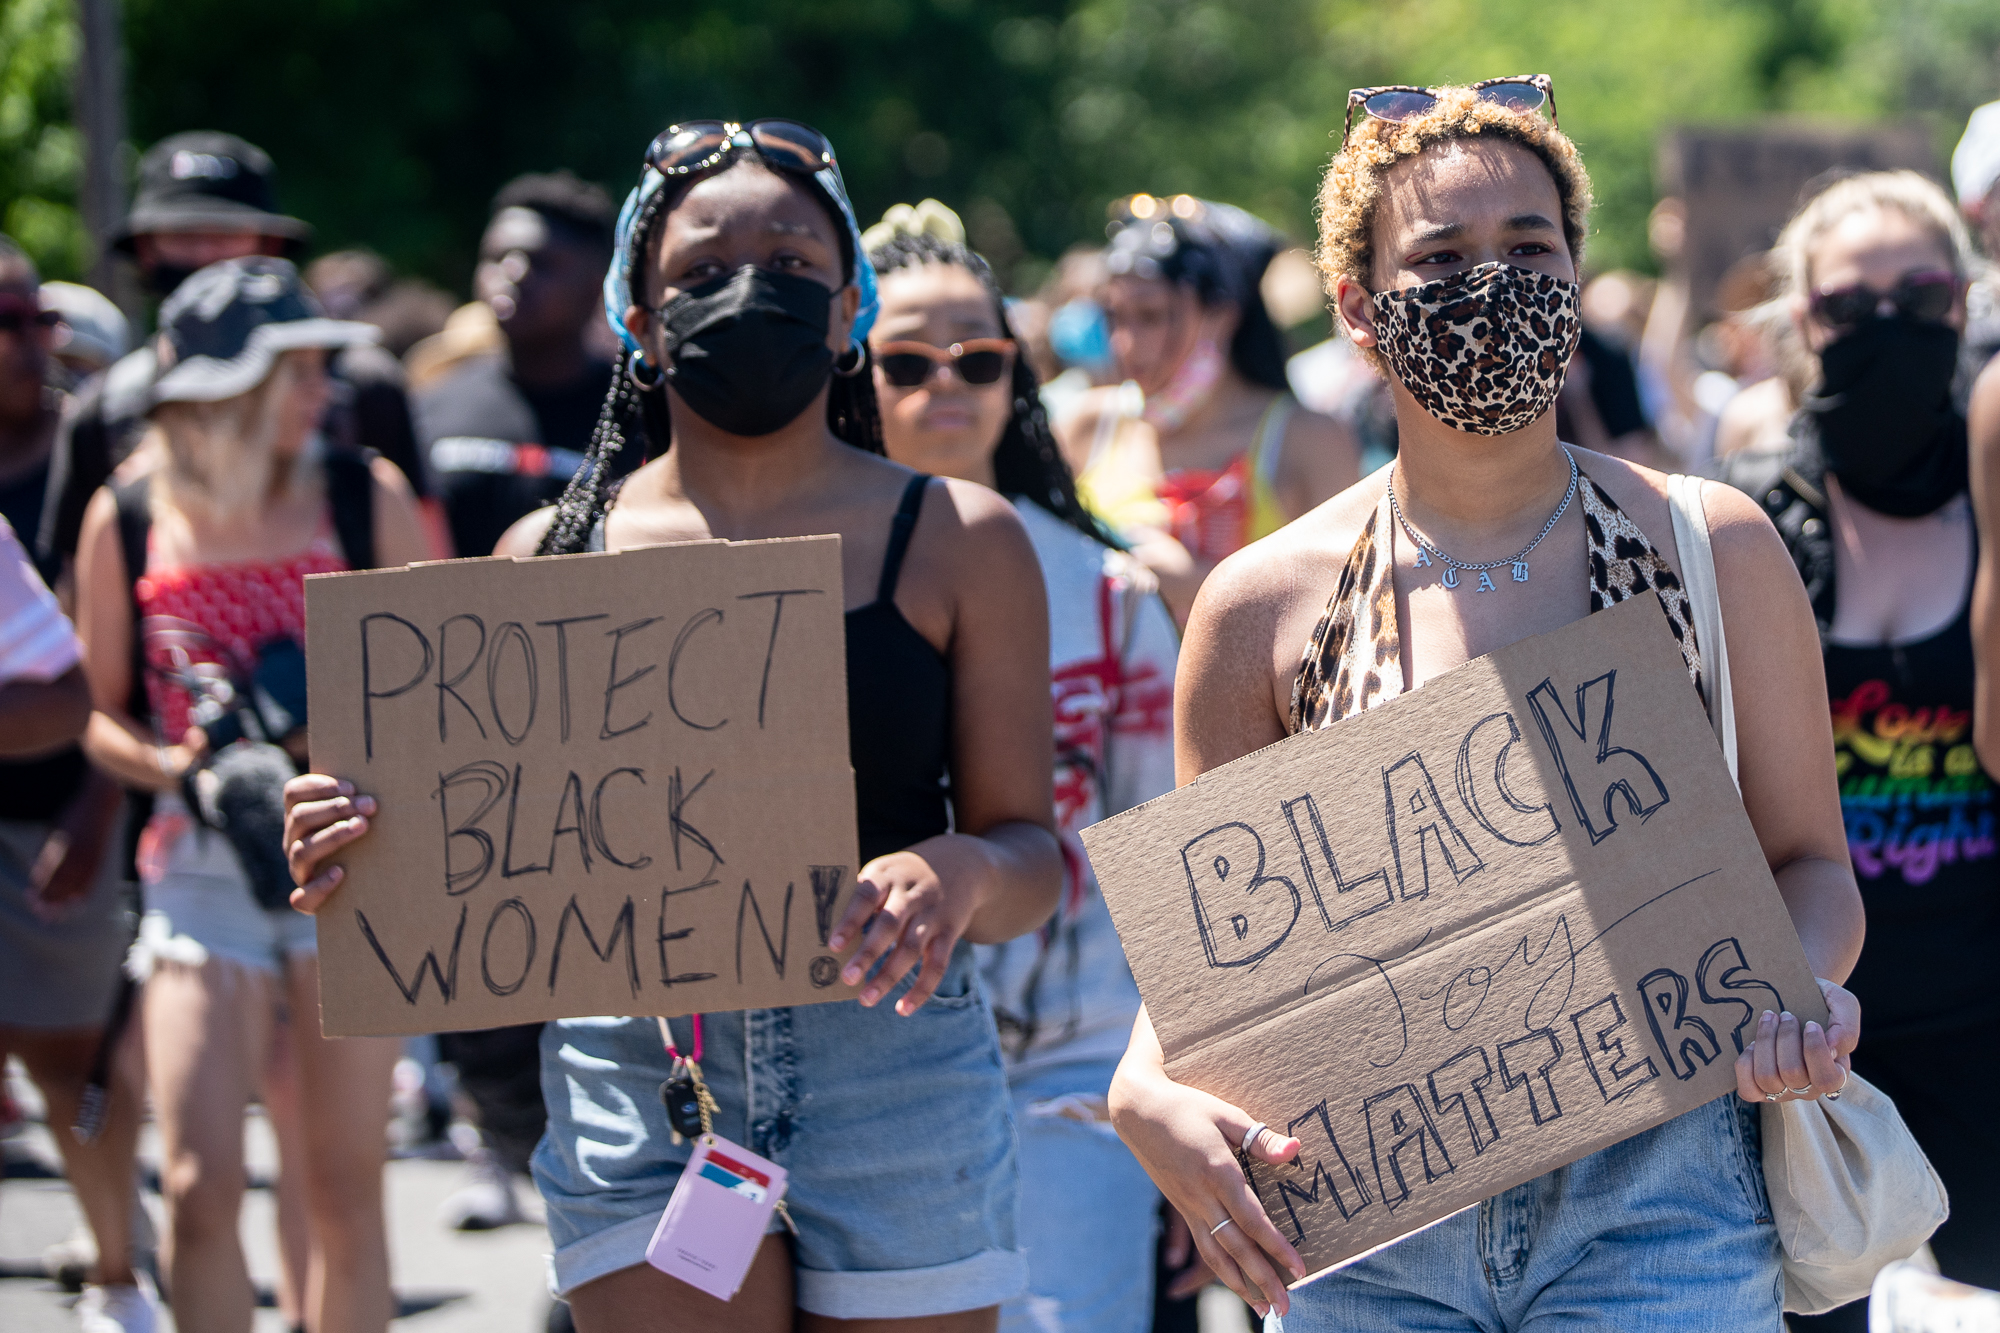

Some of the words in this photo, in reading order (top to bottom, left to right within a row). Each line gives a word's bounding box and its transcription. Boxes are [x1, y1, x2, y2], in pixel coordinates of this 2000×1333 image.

[1412, 545, 1529, 593] ACAB
[362, 589, 824, 760] PROTECT
[431, 762, 724, 896] BLACK
[1180, 669, 1670, 970] BLACK
[357, 865, 849, 1005] WOMEN!
[1303, 868, 1722, 1069] Joy
[1239, 936, 1786, 1248] MATTERS
